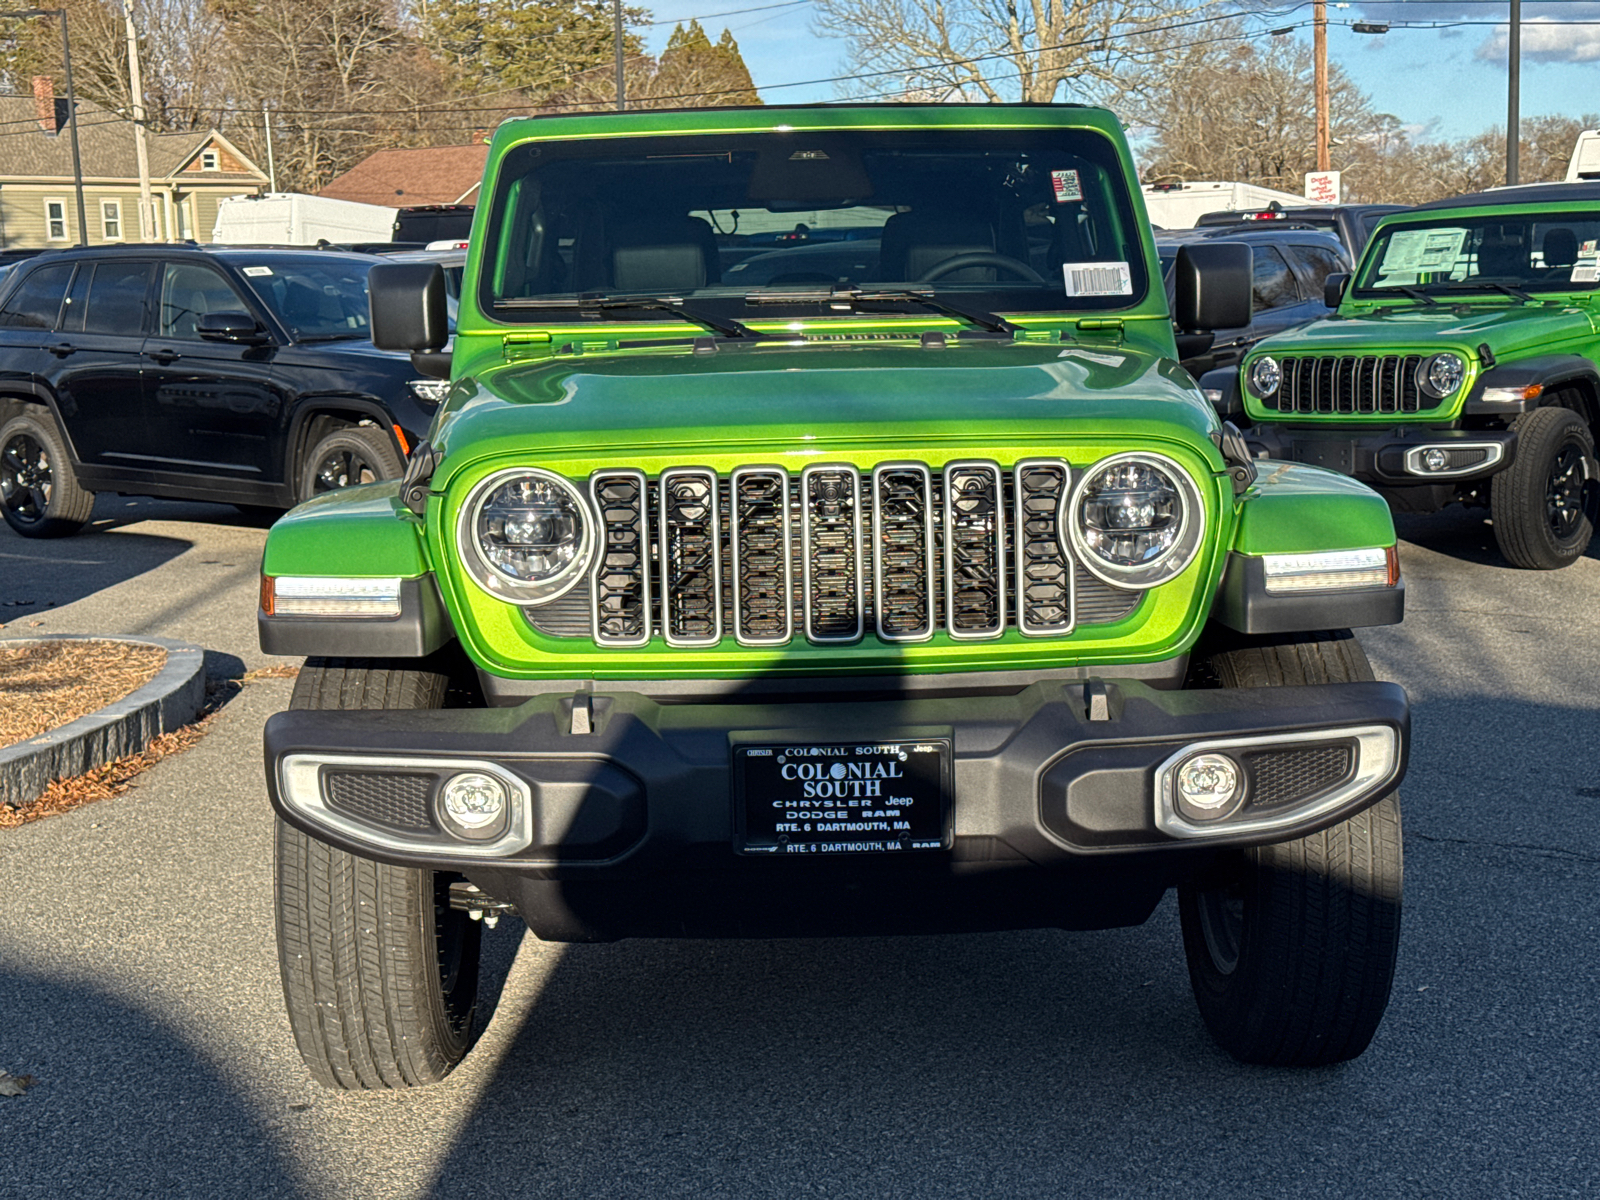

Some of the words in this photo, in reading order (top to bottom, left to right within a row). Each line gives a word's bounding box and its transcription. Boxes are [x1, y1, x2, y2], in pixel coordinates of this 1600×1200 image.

[855, 745, 900, 755] SOUTH
[913, 745, 933, 753] Jeep
[803, 780, 882, 798] SOUTH
[772, 800, 872, 808] CHRYSLER
[885, 796, 914, 807] Jeep
[786, 811, 848, 819] DODGE
[862, 810, 900, 818] RAM
[776, 823, 801, 832] RTE.
[803, 823, 811, 832] 6
[817, 822, 891, 832] DARTMOUTH,
[893, 821, 911, 830] MA
[787, 844, 808, 852] RTE.
[810, 844, 817, 852] 6
[821, 842, 885, 852] DARTMOUTH,
[886, 841, 902, 850] MA
